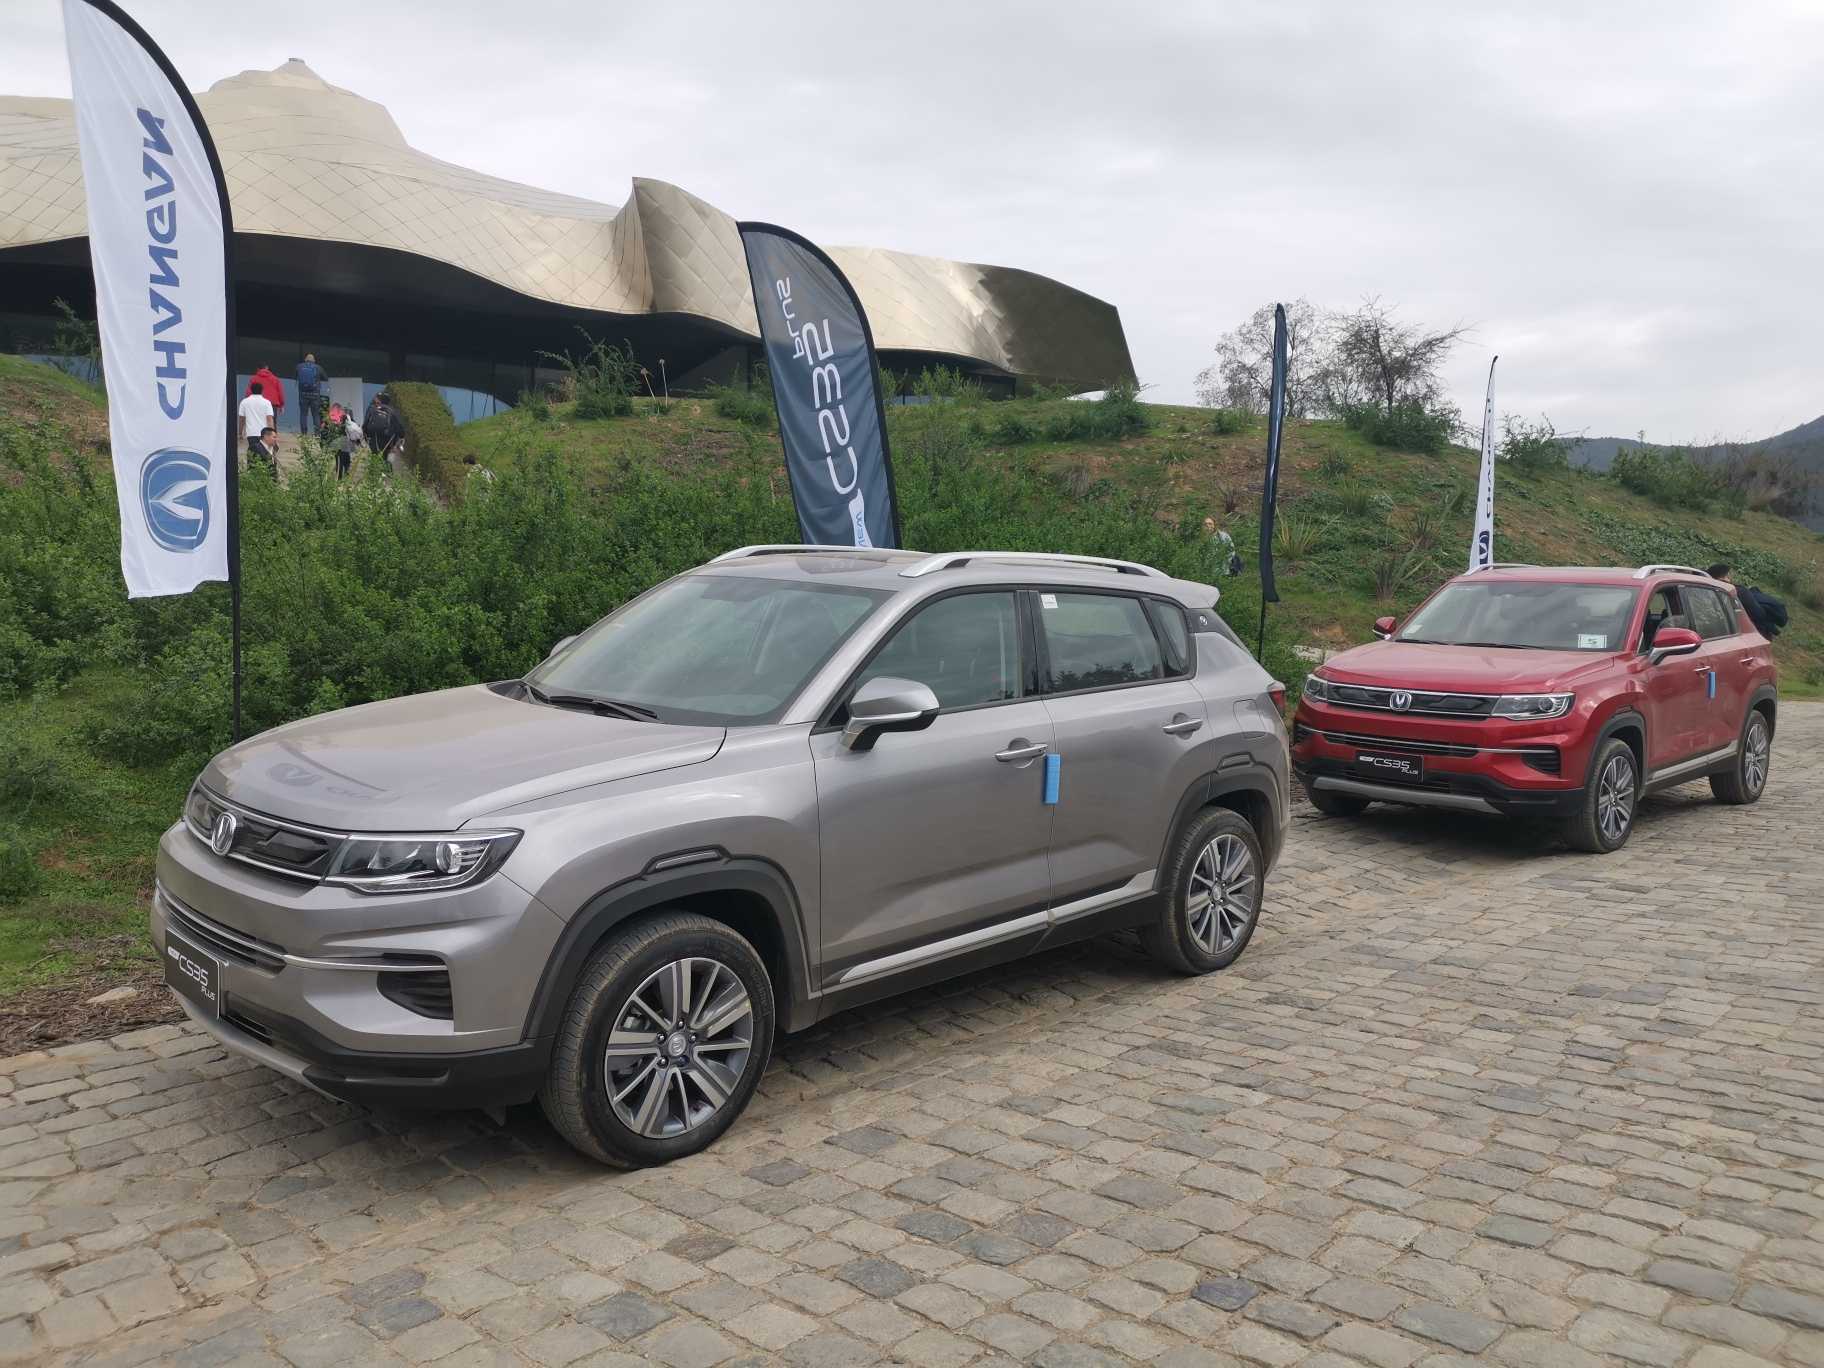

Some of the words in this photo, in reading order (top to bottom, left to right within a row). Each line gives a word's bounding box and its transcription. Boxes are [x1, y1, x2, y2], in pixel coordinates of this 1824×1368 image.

[1374, 757, 1411, 769] CS35
[179, 954, 208, 986] CS35
[201, 985, 216, 1001] PLUS
